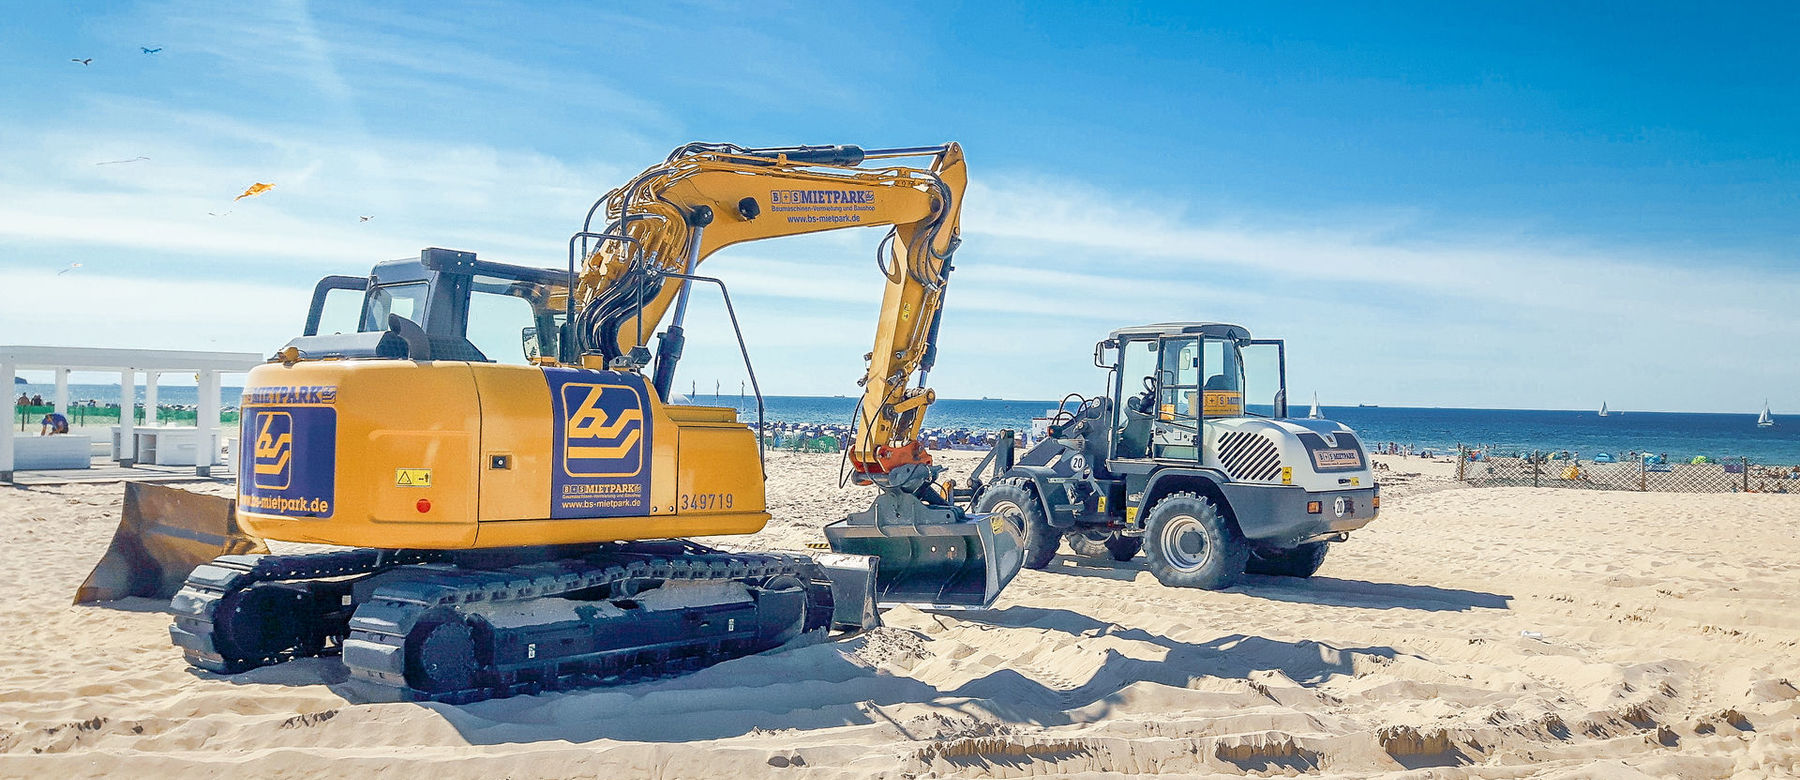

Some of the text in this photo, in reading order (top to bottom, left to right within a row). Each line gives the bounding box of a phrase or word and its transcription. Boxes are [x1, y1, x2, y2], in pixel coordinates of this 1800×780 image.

[787, 213, 861, 223] www.bs-mietpark.de
[1073, 457, 1083, 469] 20
[562, 499, 641, 508] www.bs-mietpark.de
[681, 493, 733, 510] 349719
[1336, 500, 1343, 513] 20
